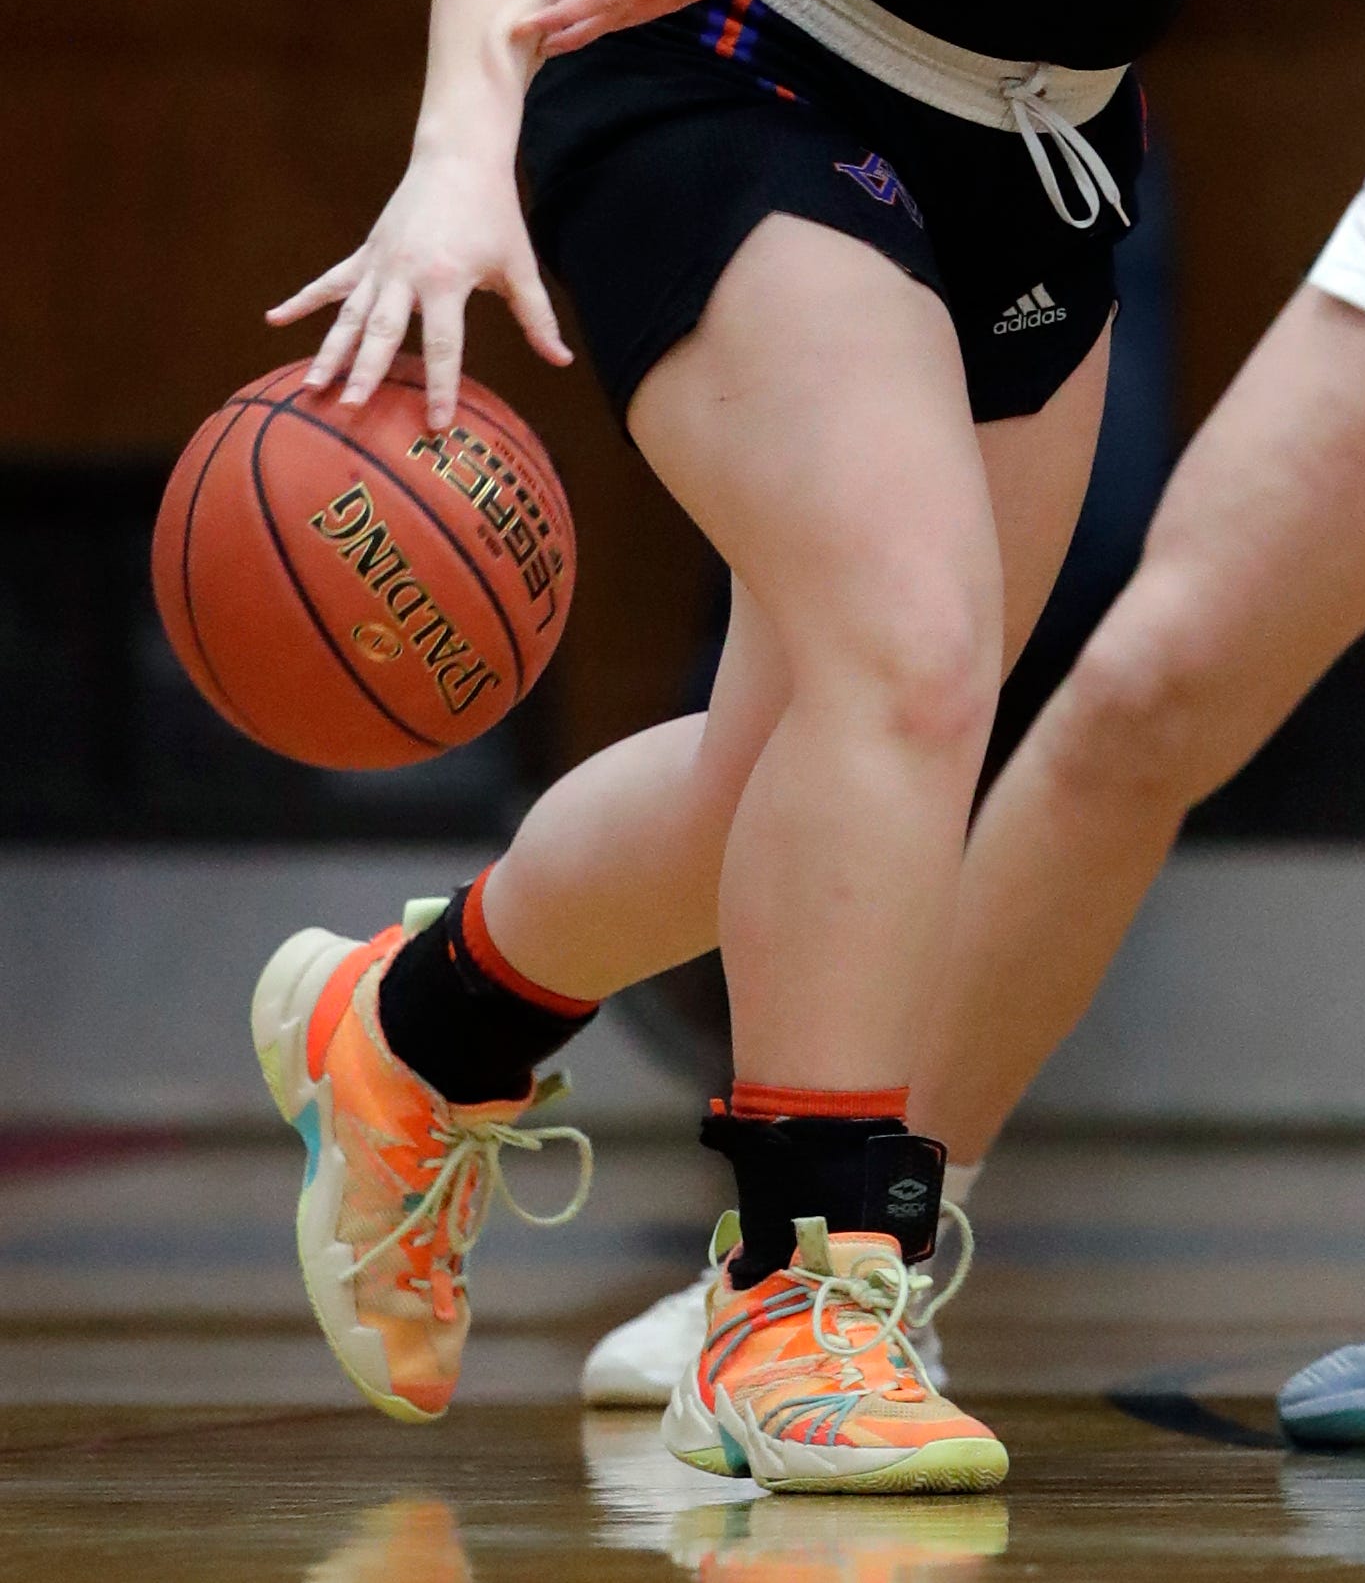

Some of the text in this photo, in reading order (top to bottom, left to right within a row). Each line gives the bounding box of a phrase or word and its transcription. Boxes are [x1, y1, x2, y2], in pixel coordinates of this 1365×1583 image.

[992, 306, 1068, 335] adidas
[309, 480, 500, 715] SPALDING
[406, 433, 557, 635] LEGACY
